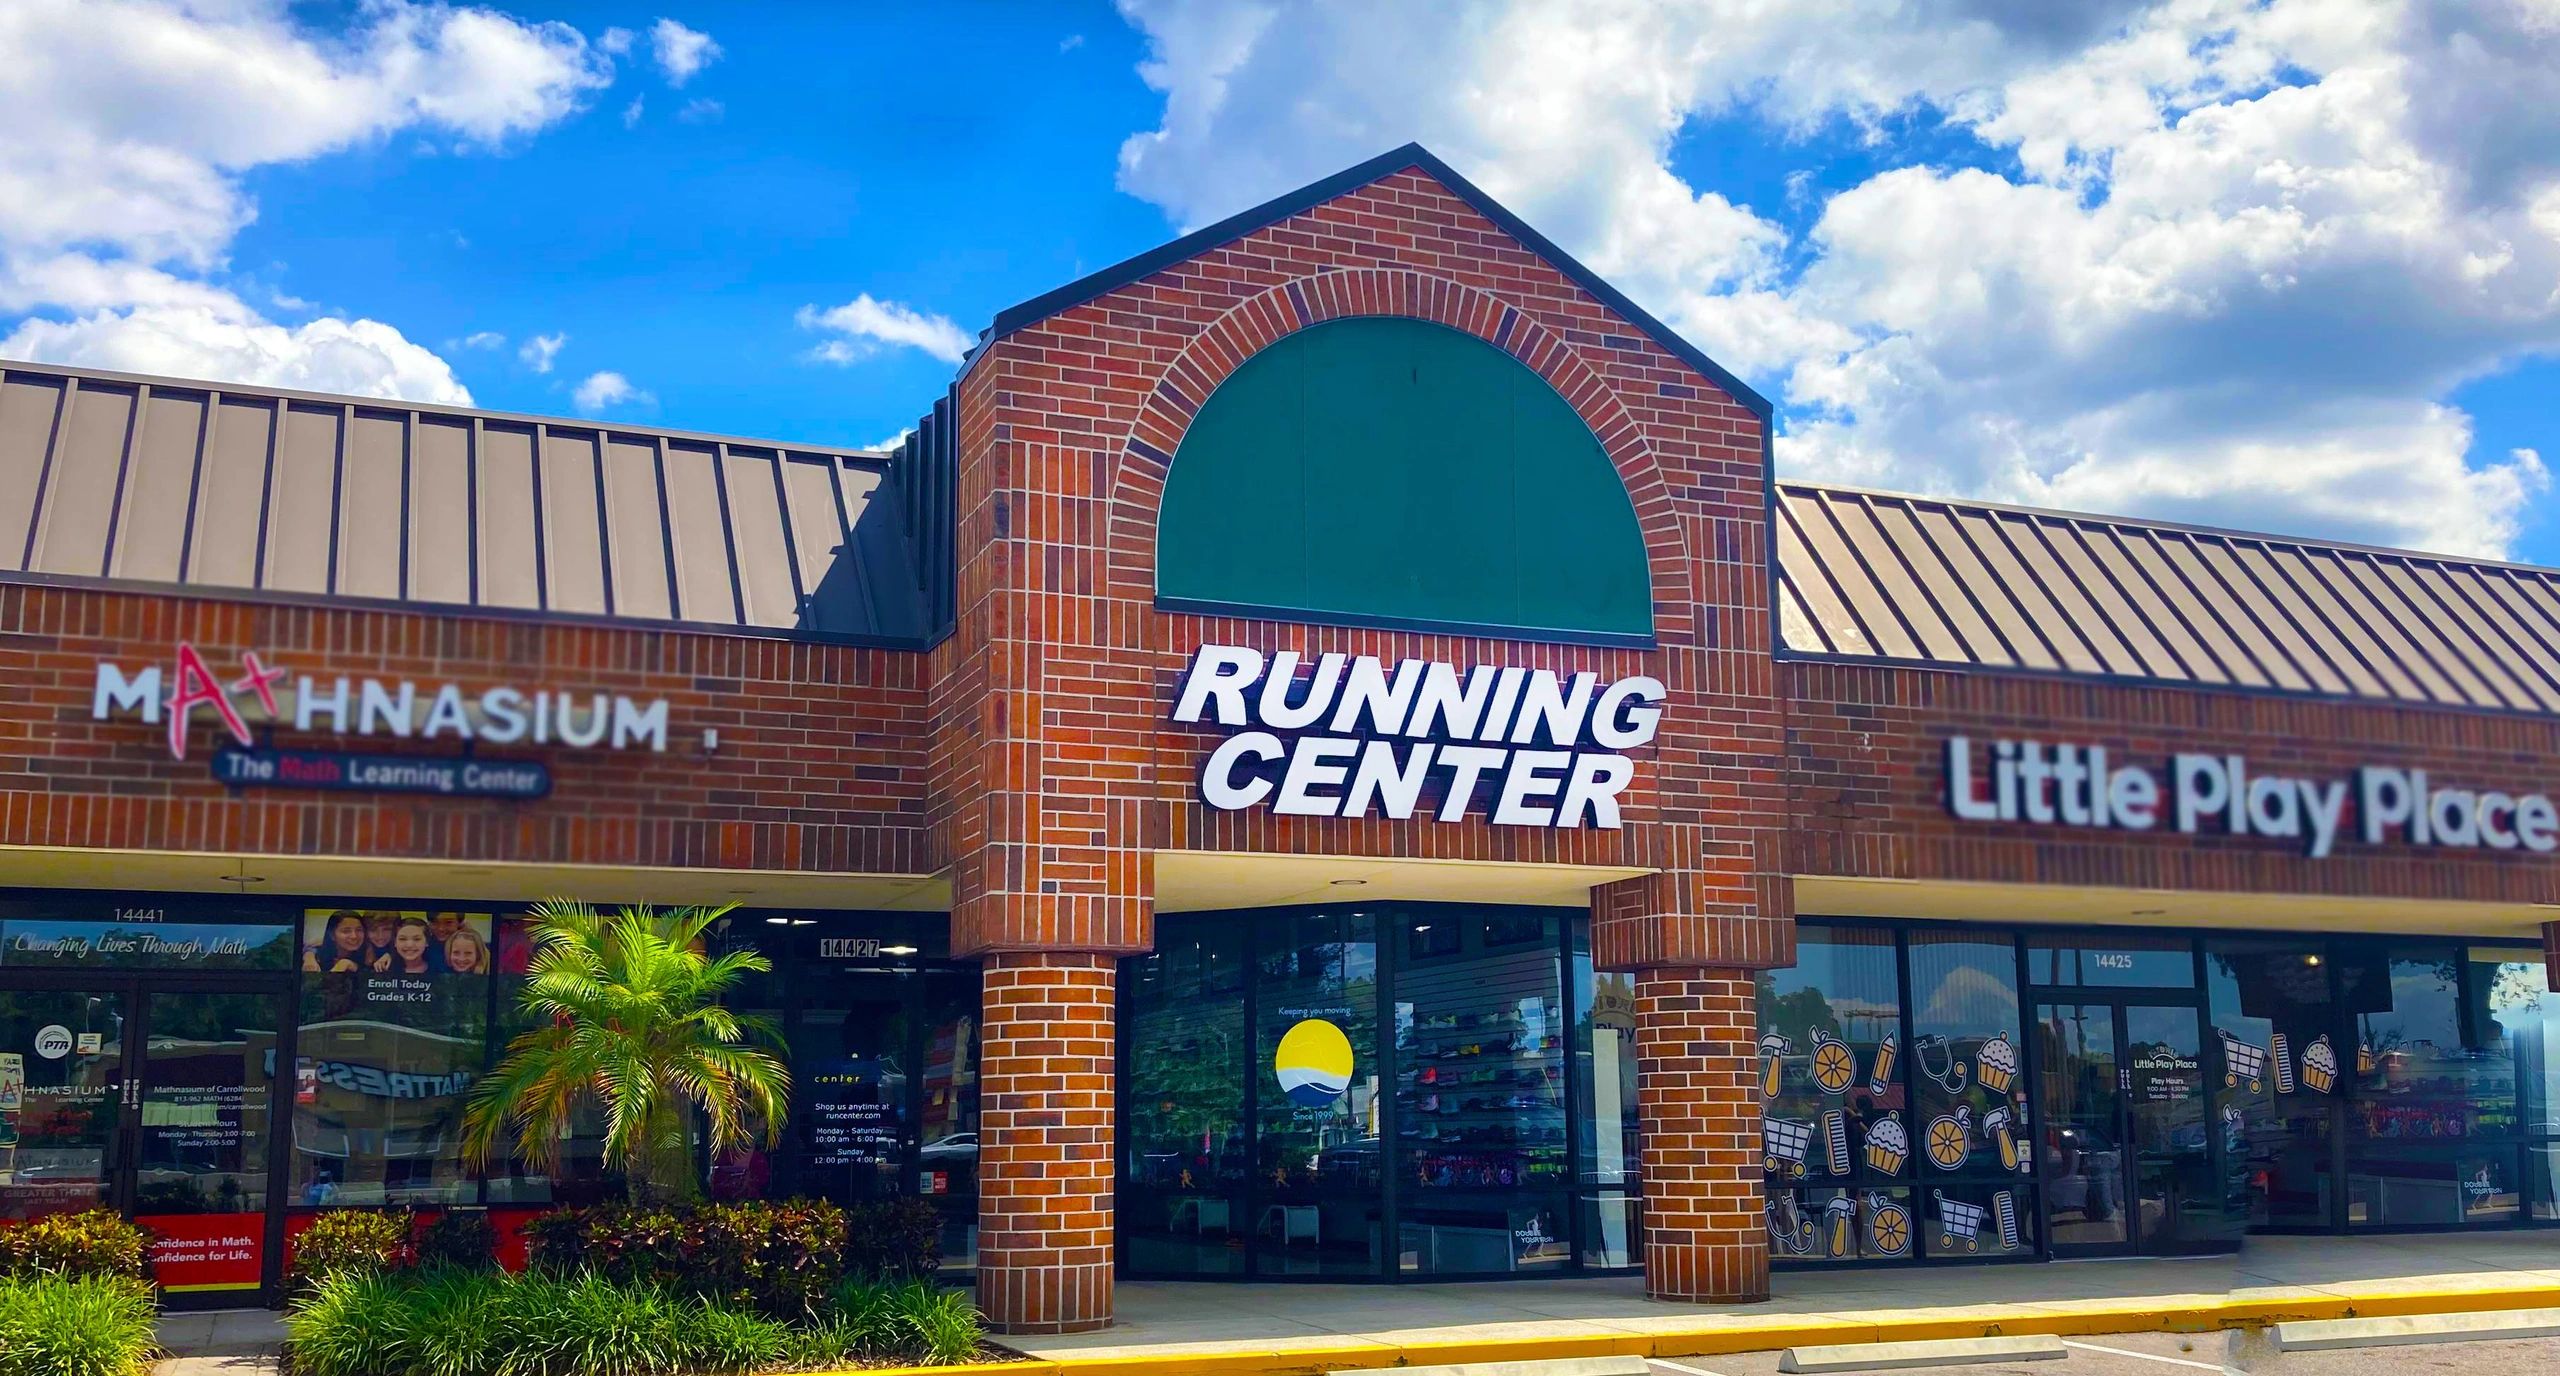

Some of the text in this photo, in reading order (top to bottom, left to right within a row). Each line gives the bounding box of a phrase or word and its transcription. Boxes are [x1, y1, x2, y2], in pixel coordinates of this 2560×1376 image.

[1173, 644, 1667, 749] RUNNING
[227, 752, 537, 791] The Math Learning Center
[1202, 731, 1635, 829] CENTER
[1949, 736, 2560, 858] Little Play Place
[114, 908, 164, 922] 14441
[15, 931, 248, 960] Changing Lives Through Math
[822, 940, 879, 956] 14427
[2094, 954, 2132, 968] 14425
[367, 978, 432, 991] Enroll Today
[367, 991, 432, 1002] Grades K-12
[1278, 1006, 1352, 1018] Keeping you moving
[44, 1040, 70, 1050] PTA
[2134, 1059, 2198, 1070] Little Play Place
[814, 1074, 860, 1082] center
[153, 1085, 266, 1093] Mathnasium of Carrollwood
[815, 1103, 836, 1111] Shop
[848, 1103, 880, 1111] anytime
[1292, 1110, 1334, 1120] Since 1999
[158, 1131, 187, 1139] Monday
[191, 1130, 223, 1138] Thursday
[816, 1127, 844, 1135] Monday
[851, 1127, 884, 1135] Saturday
[837, 1148, 865, 1156] Sunday
[151, 1236, 255, 1248] nfidence in Math.
[151, 1249, 253, 1262] nfidence for Life.
